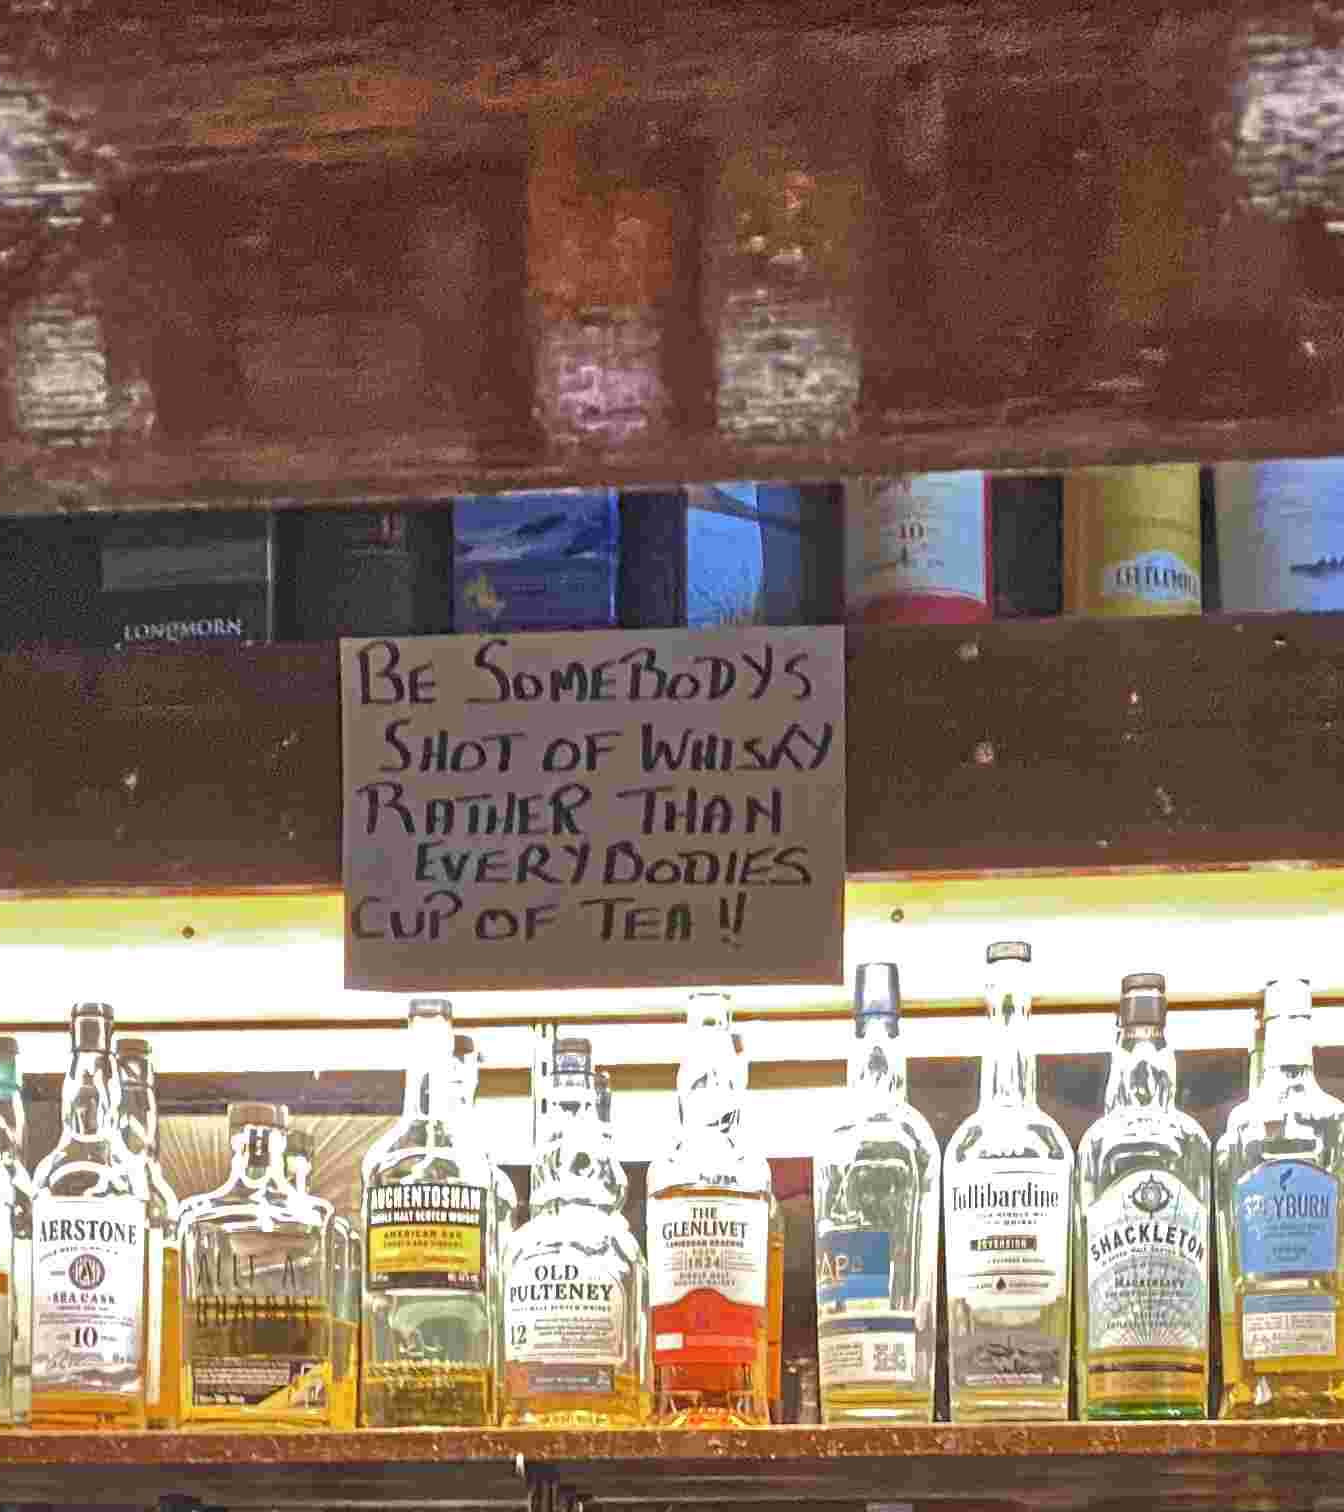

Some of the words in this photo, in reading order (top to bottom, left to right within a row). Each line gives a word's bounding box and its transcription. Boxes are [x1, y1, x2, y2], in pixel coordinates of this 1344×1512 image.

[123, 616, 242, 641] LONGMORN
[356, 639, 437, 705] BE
[464, 639, 815, 705] SOMEBODYS
[379, 719, 528, 773] SHOT
[541, 730, 624, 773] OF
[639, 721, 833, 773] WHISKY
[356, 781, 593, 836] RATHER
[615, 785, 783, 836] THAN
[351, 890, 463, 940] CUP
[473, 904, 559, 941] OF
[580, 896, 693, 941] TEA
[371, 1185, 481, 1209] AUCHENTOSHAN
[951, 1181, 1059, 1212] Tullibardine
[690, 1206, 719, 1219] THE
[39, 1218, 137, 1246] AERSTONE
[662, 1220, 749, 1241] GLENLIVET
[534, 1262, 580, 1283] OLD
[509, 1282, 615, 1303] PULTENEY
[74, 1326, 100, 1349] 10
[510, 1323, 529, 1348] 12
